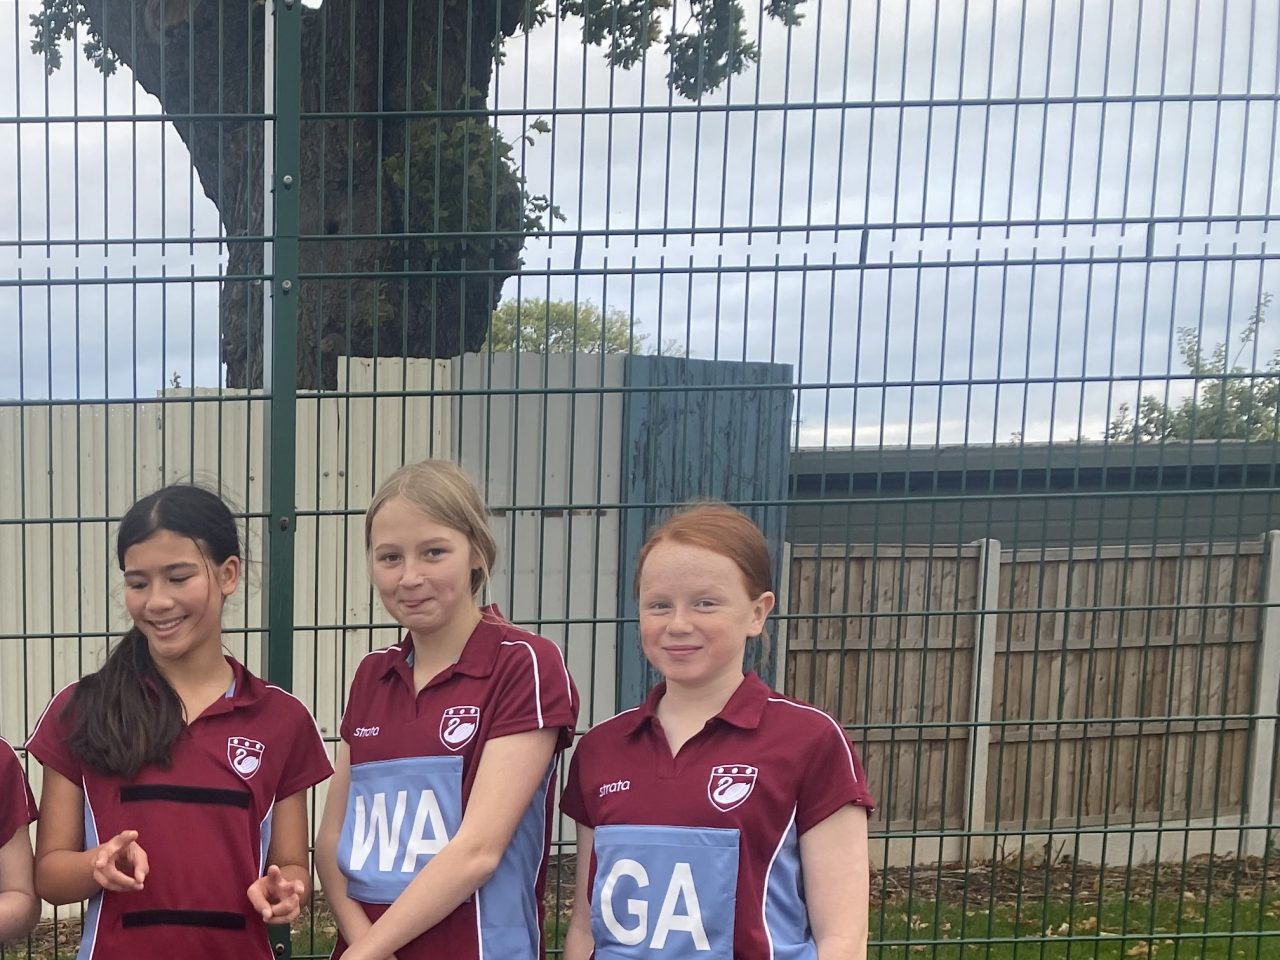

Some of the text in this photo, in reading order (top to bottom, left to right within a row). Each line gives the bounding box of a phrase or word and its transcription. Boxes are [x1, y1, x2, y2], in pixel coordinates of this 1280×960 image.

[353, 725, 380, 738] strata
[599, 778, 631, 797] strata
[349, 789, 450, 873] WA
[600, 858, 711, 951] GA
